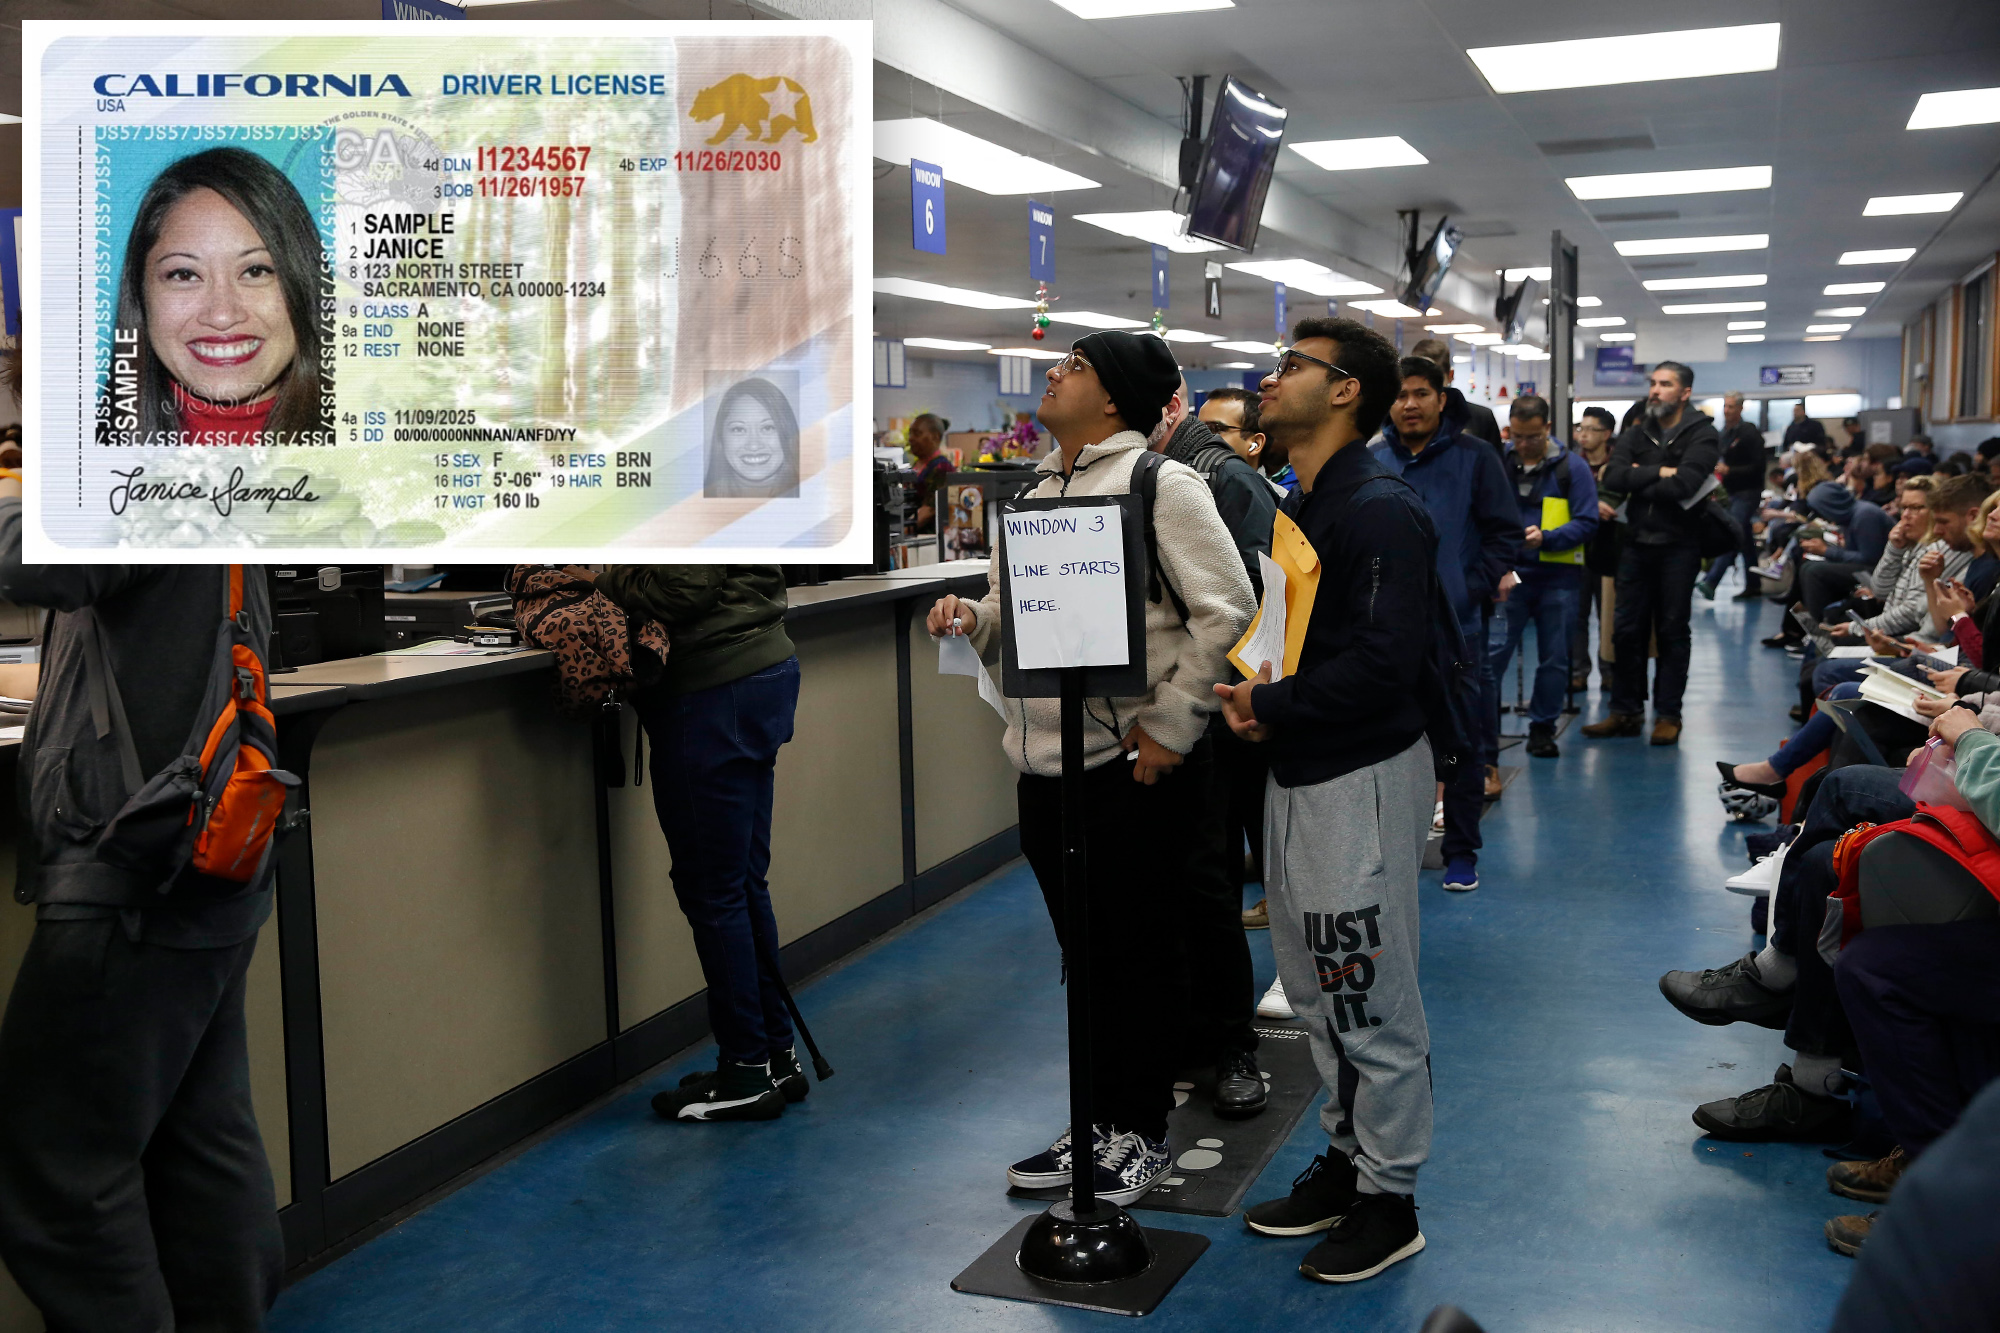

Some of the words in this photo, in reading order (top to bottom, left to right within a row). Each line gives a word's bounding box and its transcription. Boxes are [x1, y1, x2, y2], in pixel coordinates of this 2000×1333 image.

[393, 0, 452, 20] WIND
[915, 168, 941, 188] WINDOW
[925, 199, 934, 235] 6
[1032, 208, 1053, 226] WINDOW
[1040, 235, 1047, 265] 7
[1210, 282, 1220, 315] A
[1007, 518, 1076, 536] WINDOW
[1088, 515, 1105, 533] 3
[1013, 564, 1049, 579] LINE
[1059, 560, 1120, 576] STARTS
[1019, 599, 1061, 614] HERE.
[1303, 904, 1382, 954] JUST
[1314, 953, 1375, 993] DO
[1332, 993, 1383, 1034] IT.
